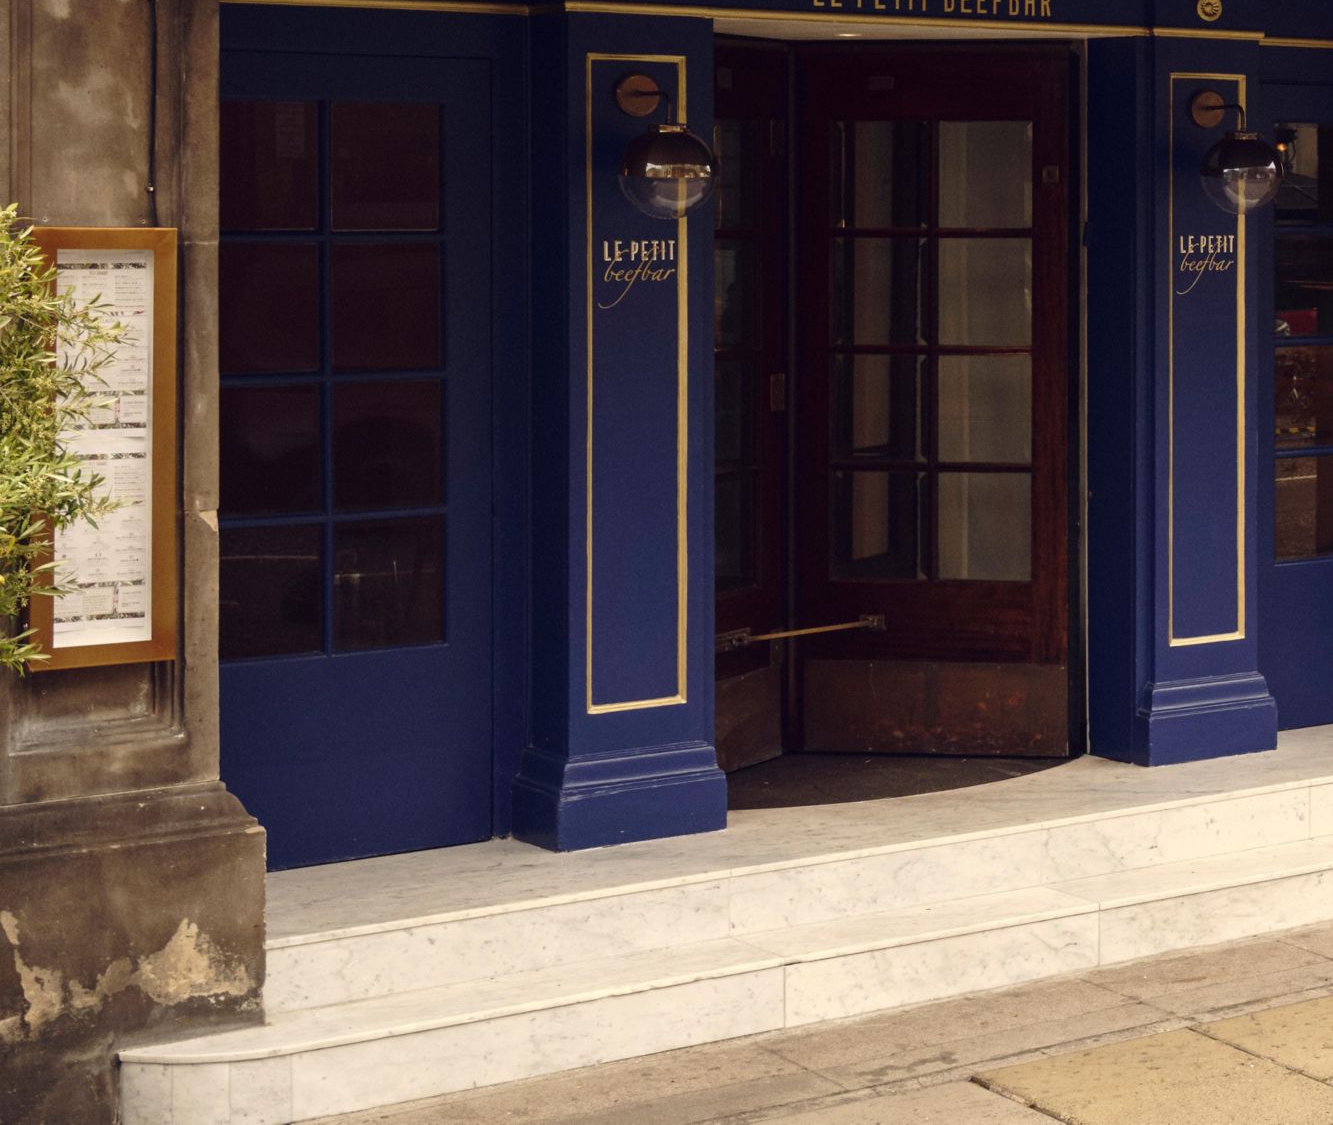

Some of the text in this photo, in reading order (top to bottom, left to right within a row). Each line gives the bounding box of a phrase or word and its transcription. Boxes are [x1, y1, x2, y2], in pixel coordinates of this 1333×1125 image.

[603, 240, 676, 262] LE PETIT
[1180, 235, 1235, 254] LE PETIT
[598, 248, 676, 310] beefbar
[1175, 242, 1235, 295] beefbar
